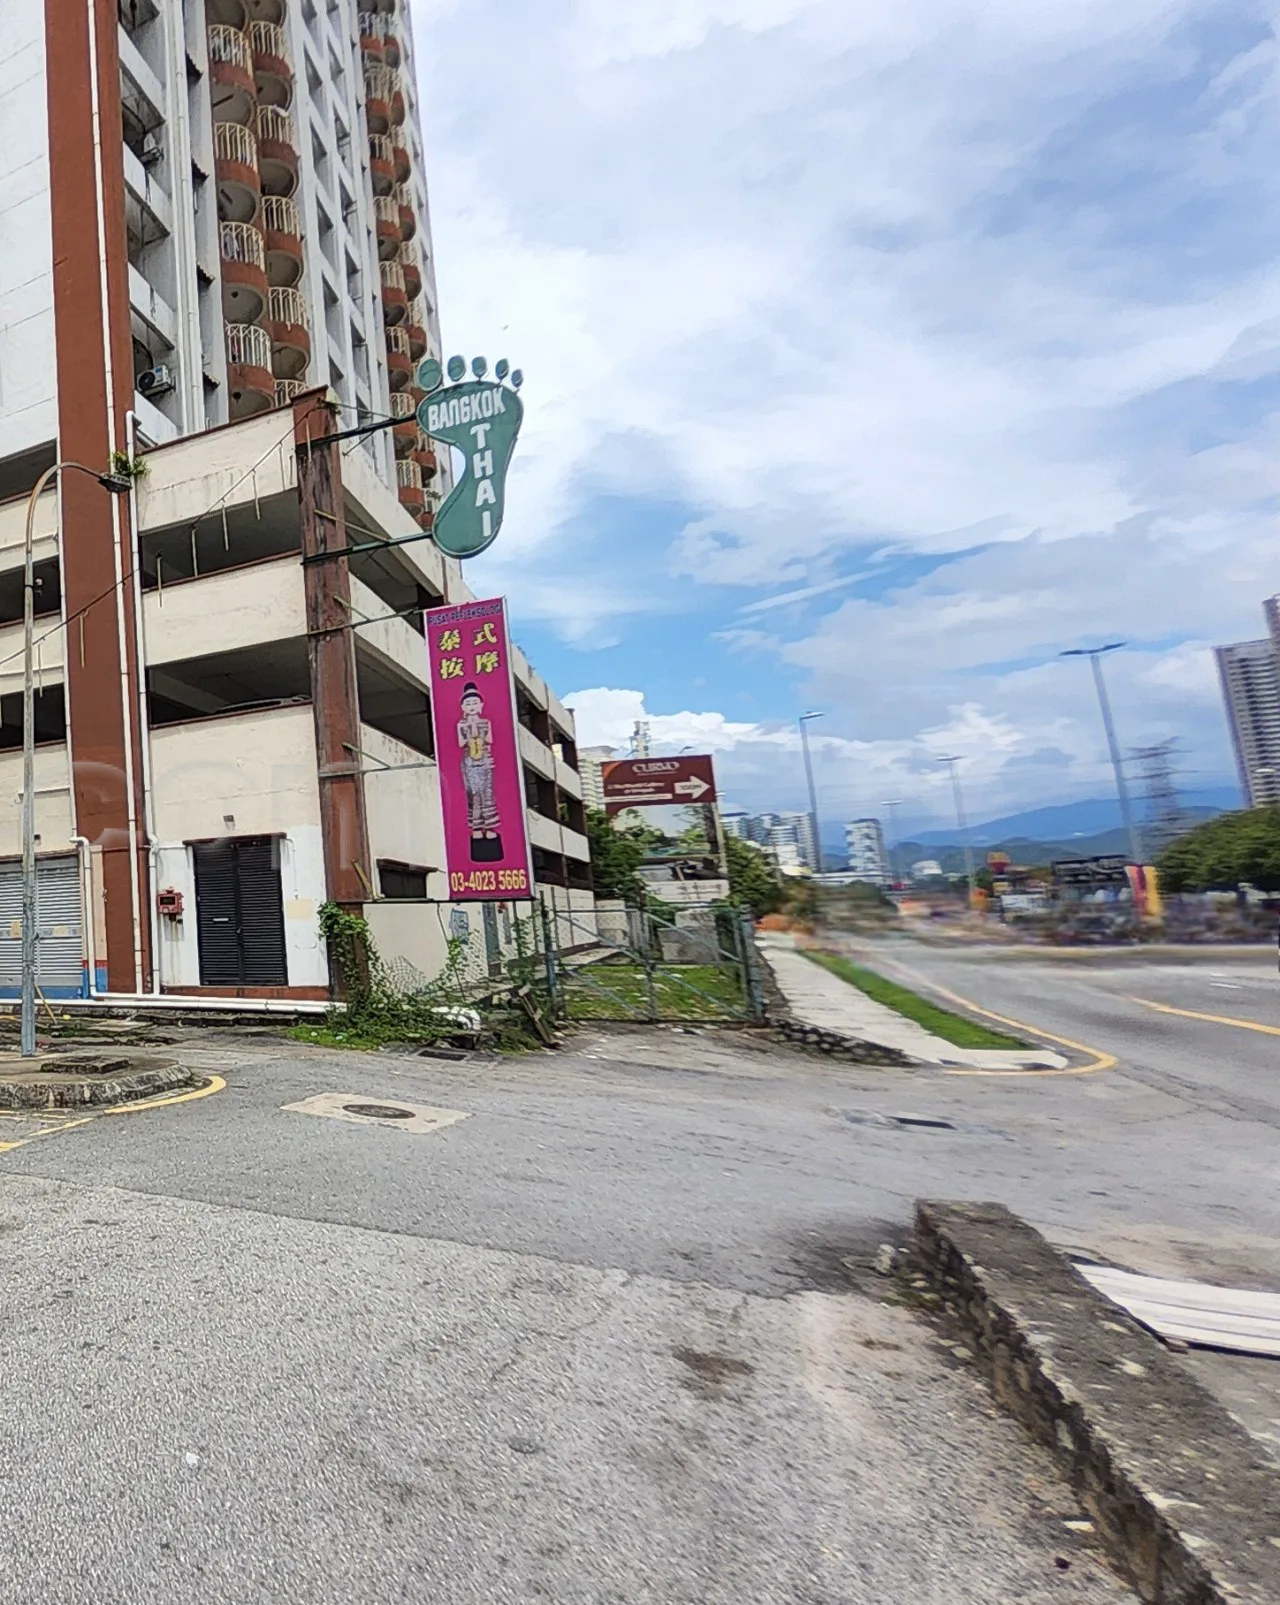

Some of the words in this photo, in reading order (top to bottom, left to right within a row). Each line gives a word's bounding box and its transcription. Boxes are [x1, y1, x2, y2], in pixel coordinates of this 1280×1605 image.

[427, 387, 506, 432] BANGKOK
[470, 423, 497, 537] THAI
[451, 870, 496, 892] 03-4023
[498, 868, 527, 889] 5666
